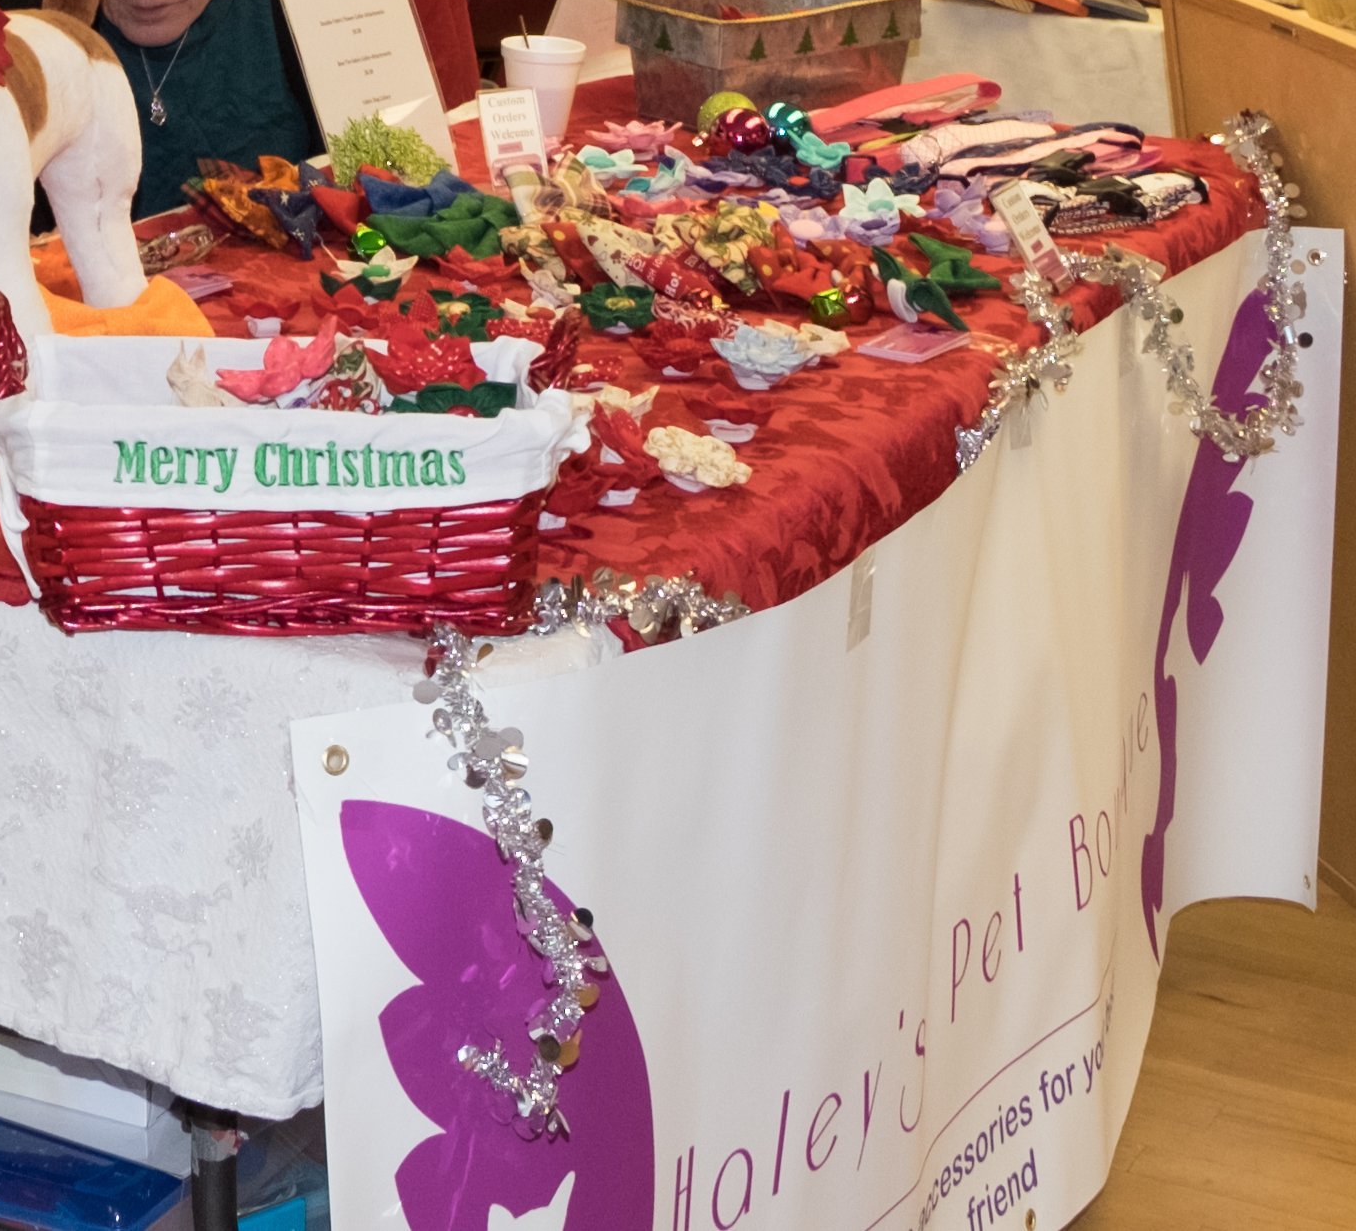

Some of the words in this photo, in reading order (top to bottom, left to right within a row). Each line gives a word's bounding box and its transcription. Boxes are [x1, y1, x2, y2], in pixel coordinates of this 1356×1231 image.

[487, 96, 526, 108] Custom
[492, 111, 527, 123] Orders
[490, 128, 534, 140] Welcome
[113, 440, 238, 493] Merry
[254, 440, 466, 488] Christmas
[672, 1009, 926, 1231] Haley's
[950, 872, 1023, 1024] Pet
[1039, 1063, 1075, 1112] for
[966, 1147, 1038, 1231] friend
